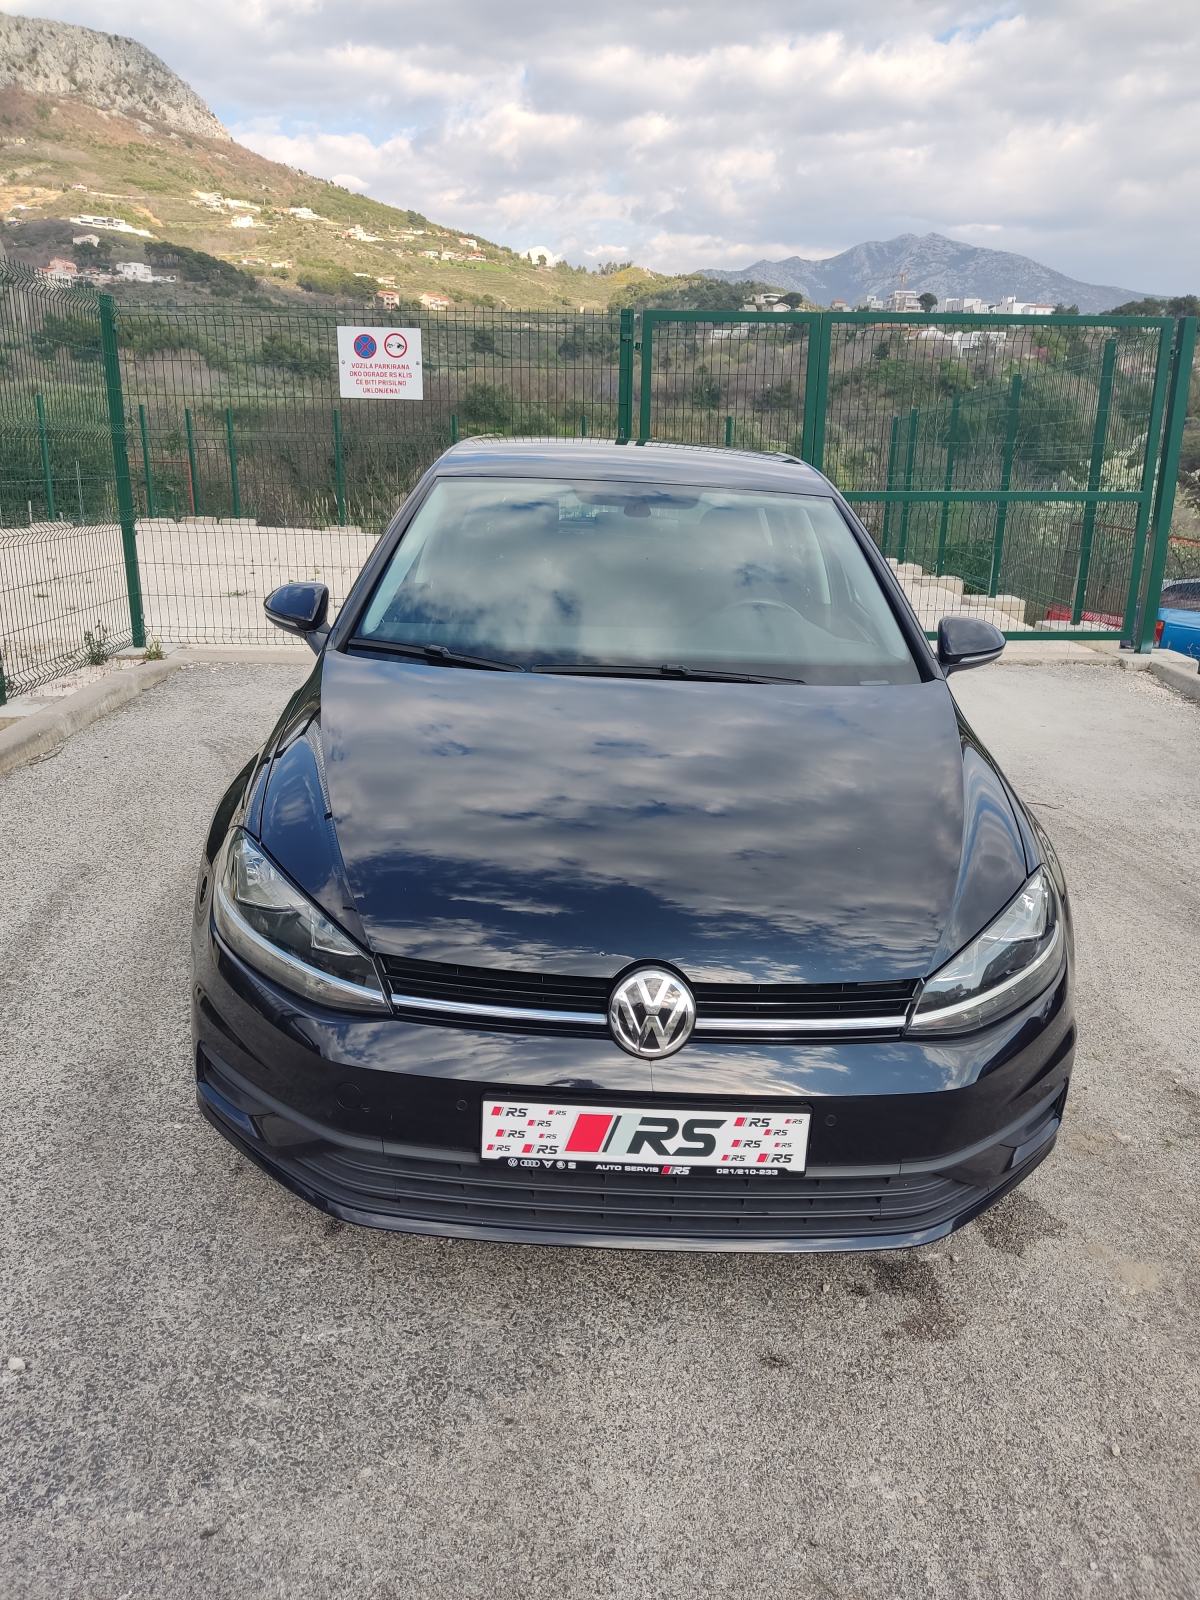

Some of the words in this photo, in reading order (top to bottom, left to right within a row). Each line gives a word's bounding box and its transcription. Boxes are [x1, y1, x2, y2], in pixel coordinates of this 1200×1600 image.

[505, 1107, 529, 1118] RS
[536, 1119, 553, 1128] RS
[749, 1117, 772, 1128] RS
[507, 1129, 527, 1139] RS
[626, 1116, 728, 1157] RS
[496, 1144, 512, 1152] RS
[742, 1139, 763, 1149] RS
[536, 1144, 560, 1155] RS
[730, 1154, 747, 1162] RS
[770, 1153, 794, 1164] RS
[624, 1165, 659, 1173] SERVIS
[671, 1166, 692, 1175] RS
[716, 1168, 778, 1176] 021/210-233
